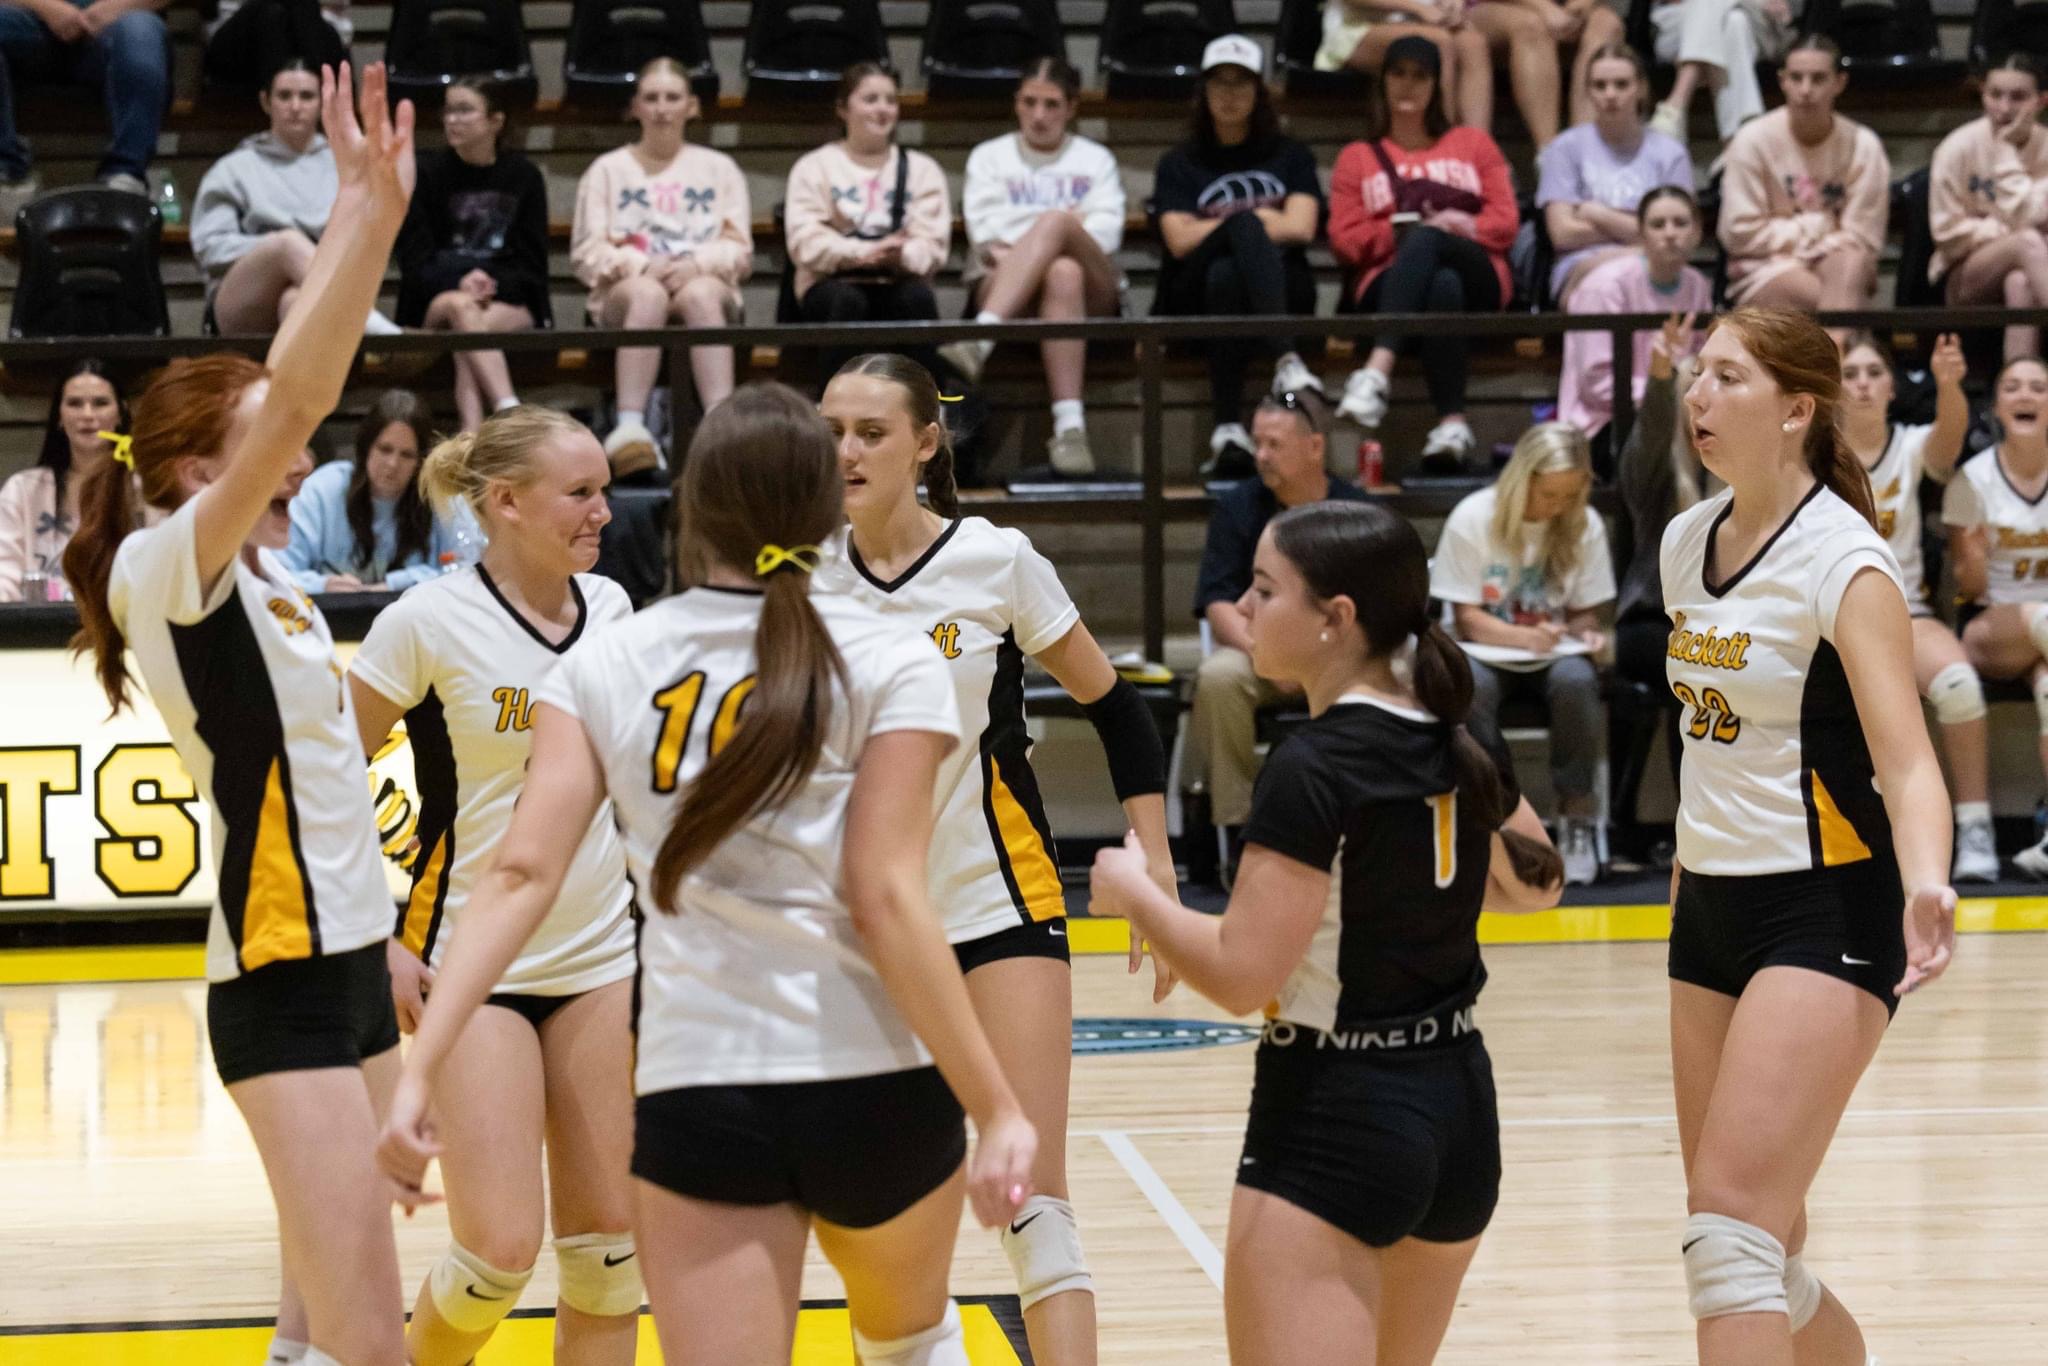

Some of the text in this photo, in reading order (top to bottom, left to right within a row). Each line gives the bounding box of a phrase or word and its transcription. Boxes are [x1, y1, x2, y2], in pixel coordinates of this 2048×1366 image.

[1673, 681, 1741, 745] 22
[0, 742, 200, 900] TS
[1424, 787, 1458, 889] 1
